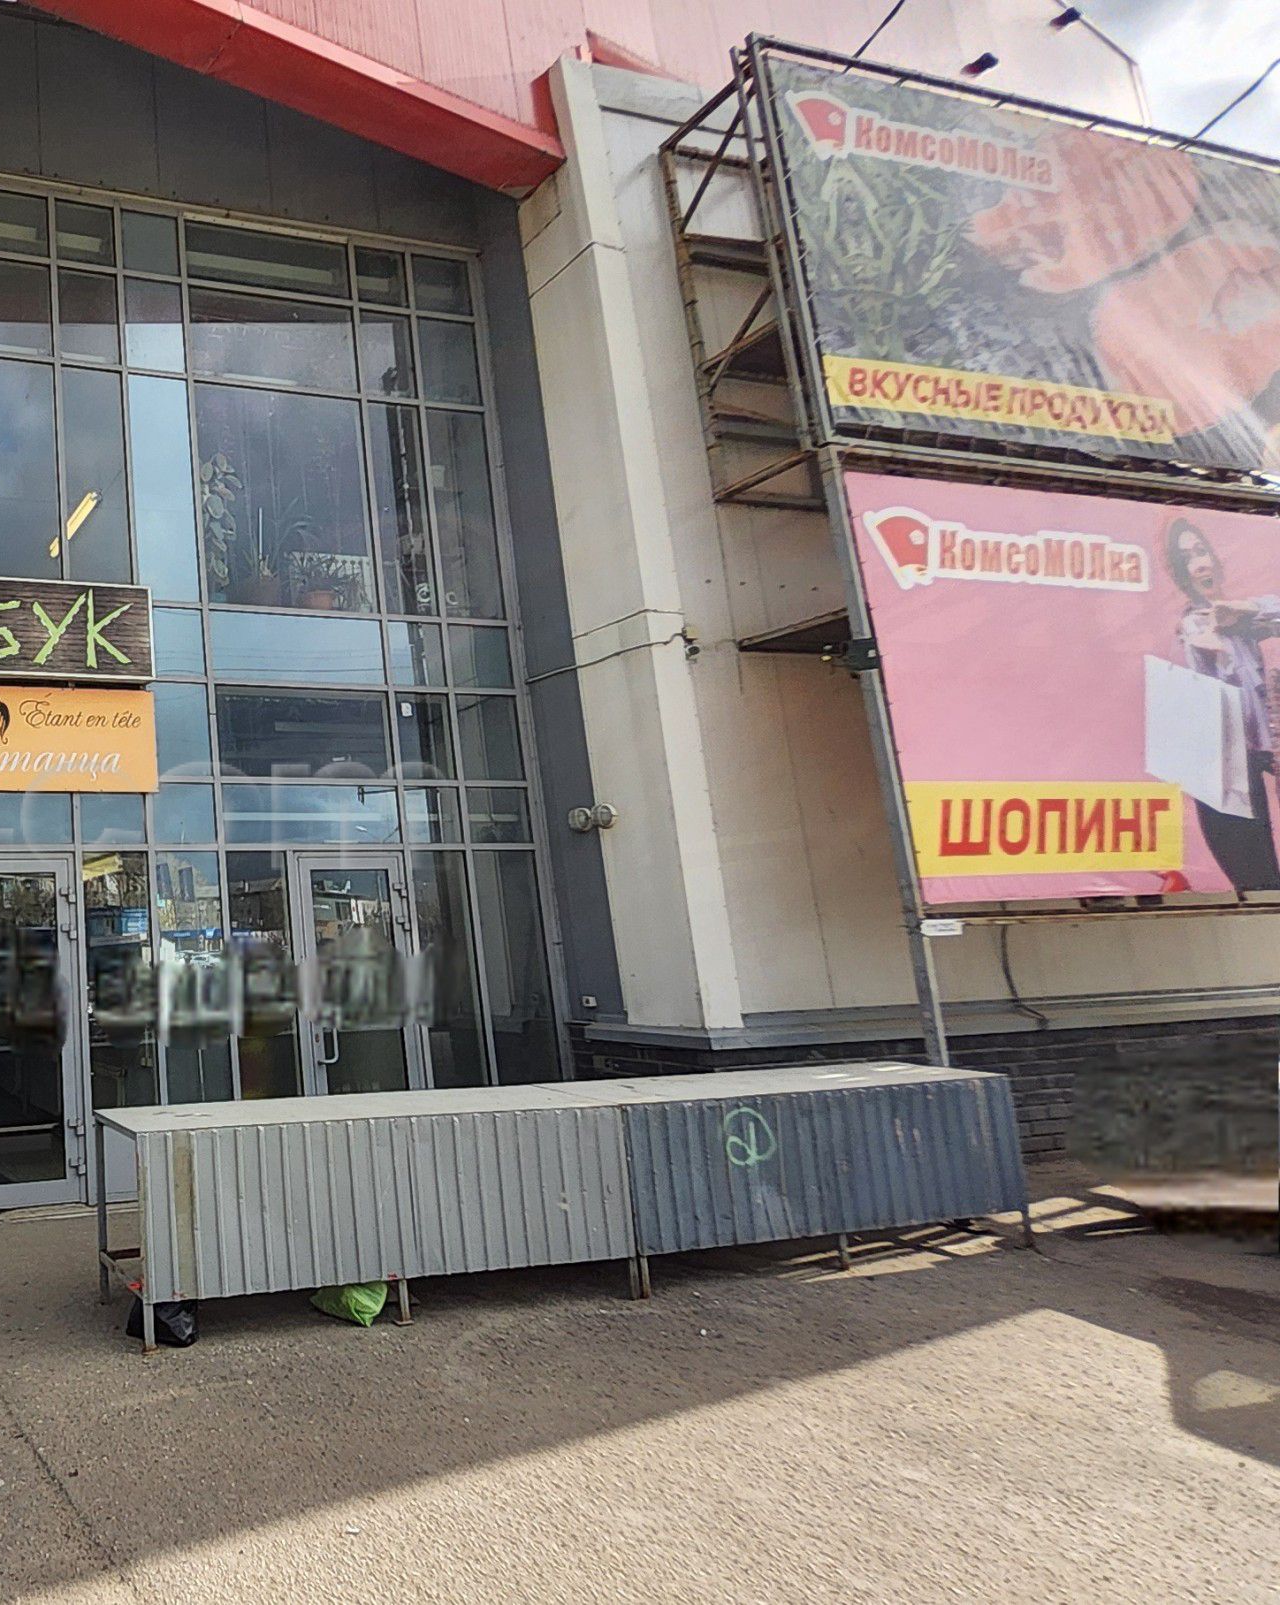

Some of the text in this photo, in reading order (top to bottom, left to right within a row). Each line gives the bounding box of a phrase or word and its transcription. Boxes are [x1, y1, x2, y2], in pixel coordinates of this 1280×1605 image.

[847, 367, 1171, 434] ВКУСНЫЕ ПРОДУКТЫ
[85, 714, 108, 728] en
[938, 798, 1171, 856] ШОПИНГ
